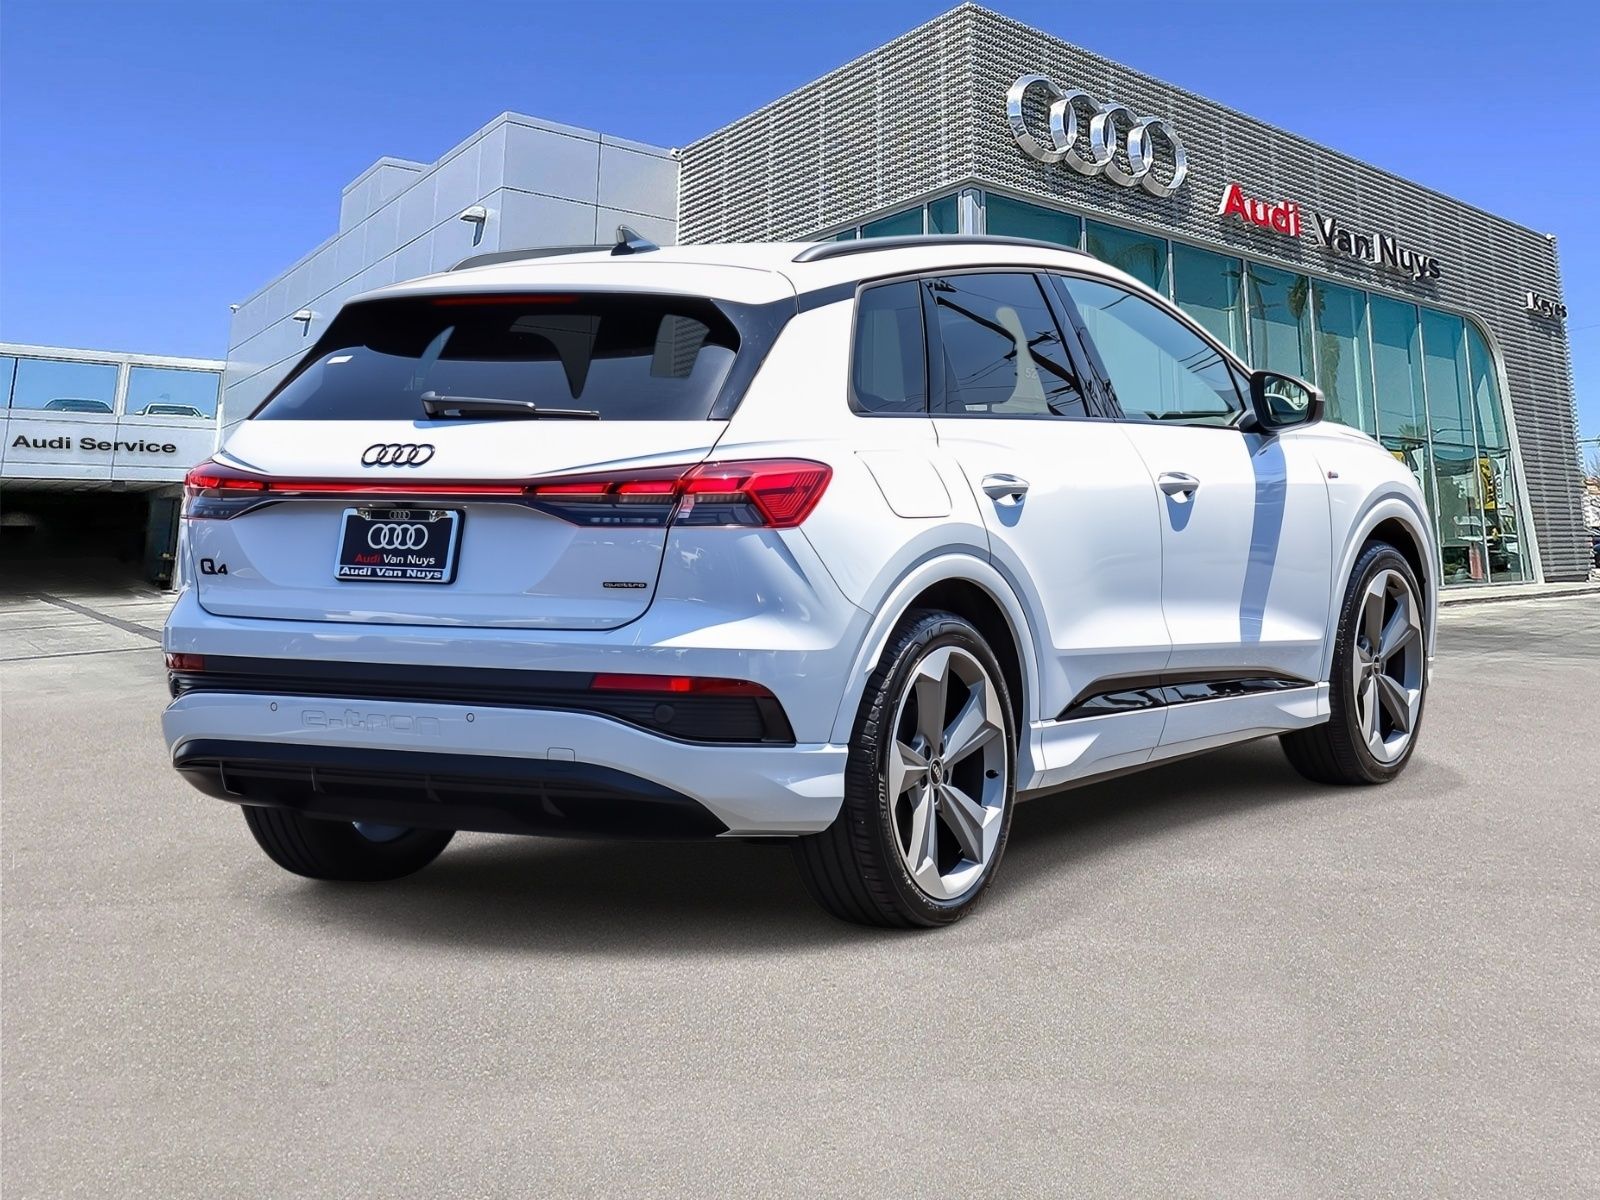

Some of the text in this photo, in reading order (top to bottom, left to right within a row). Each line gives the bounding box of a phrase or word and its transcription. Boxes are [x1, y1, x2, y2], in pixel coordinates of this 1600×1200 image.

[1217, 183, 1441, 280] Audi Van Nuys
[1526, 291, 1568, 319] Keyes
[12, 435, 177, 454] Audi Service
[200, 558, 228, 575] Q4
[355, 553, 436, 567] Audi Van Nuys
[340, 566, 442, 580] Audi Van Nuys
[301, 708, 441, 737] e-tron
